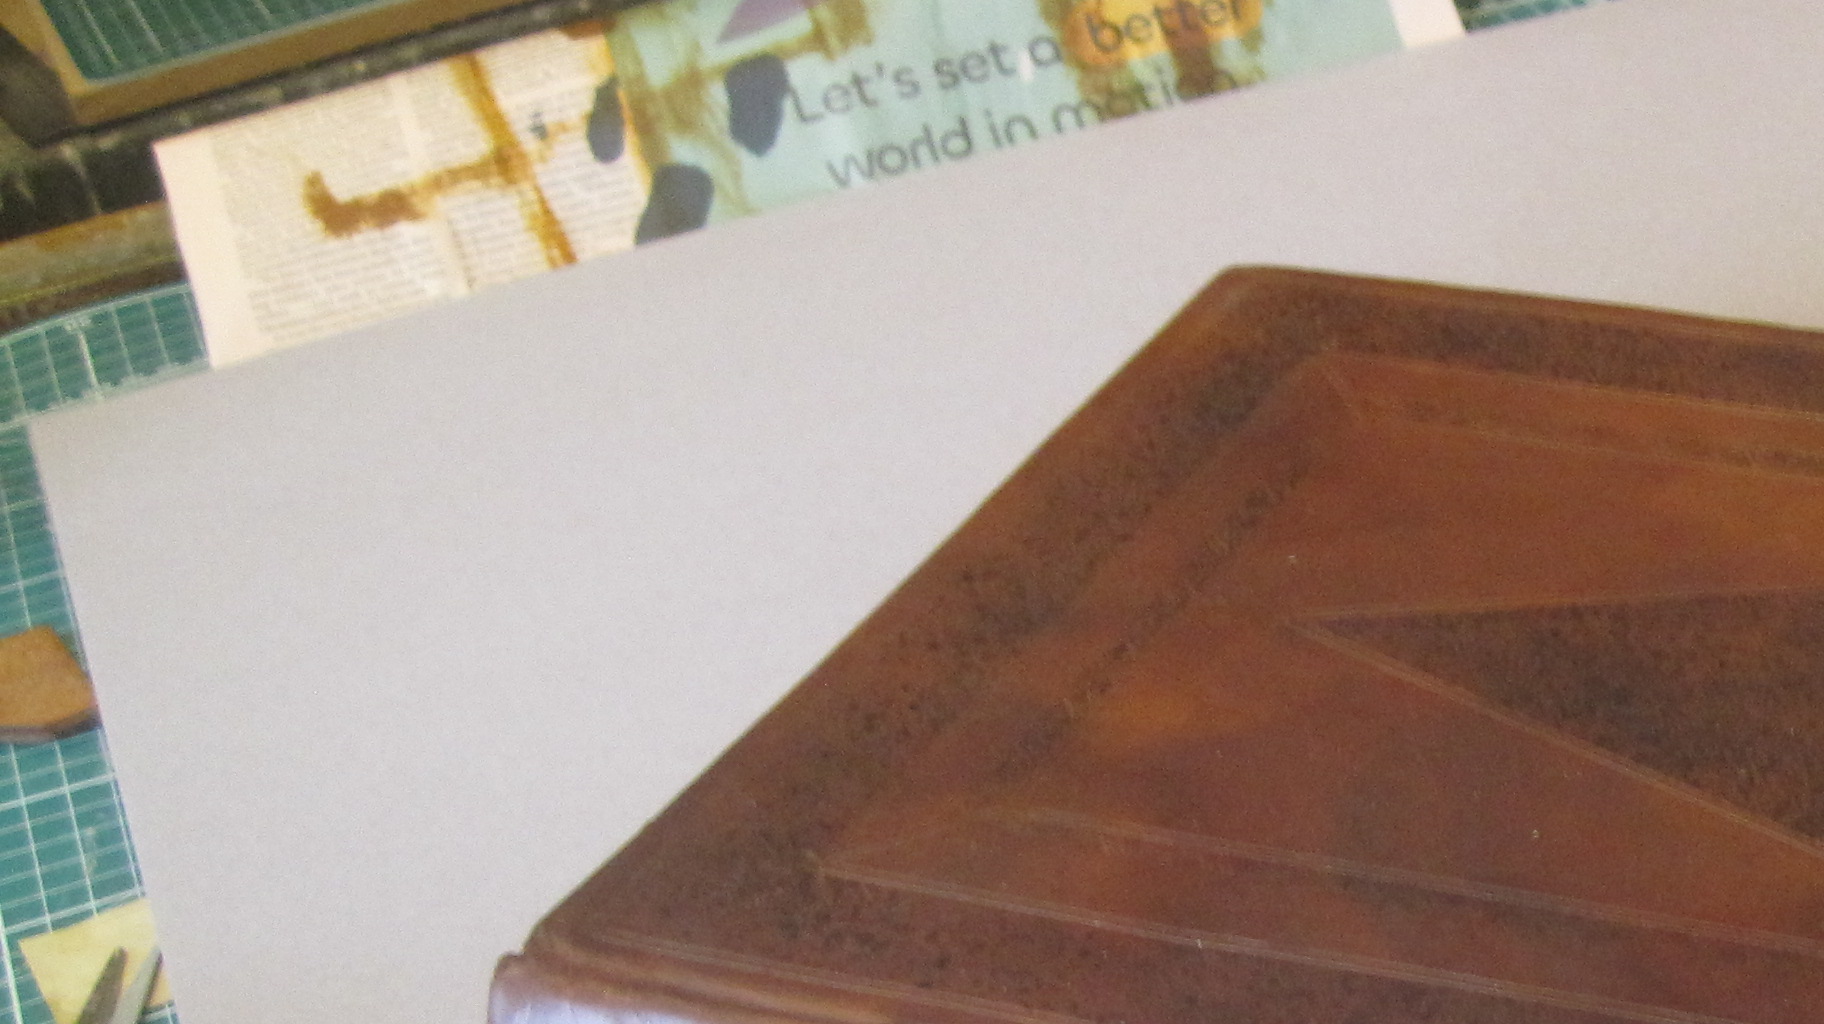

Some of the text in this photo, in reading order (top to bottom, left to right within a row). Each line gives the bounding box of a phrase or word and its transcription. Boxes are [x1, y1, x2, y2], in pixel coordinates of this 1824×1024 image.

[788, 61, 922, 123] Let's
[933, 41, 1016, 91] set
[1027, 34, 1062, 67] a
[826, 115, 973, 188] world
[983, 107, 1039, 149] in
